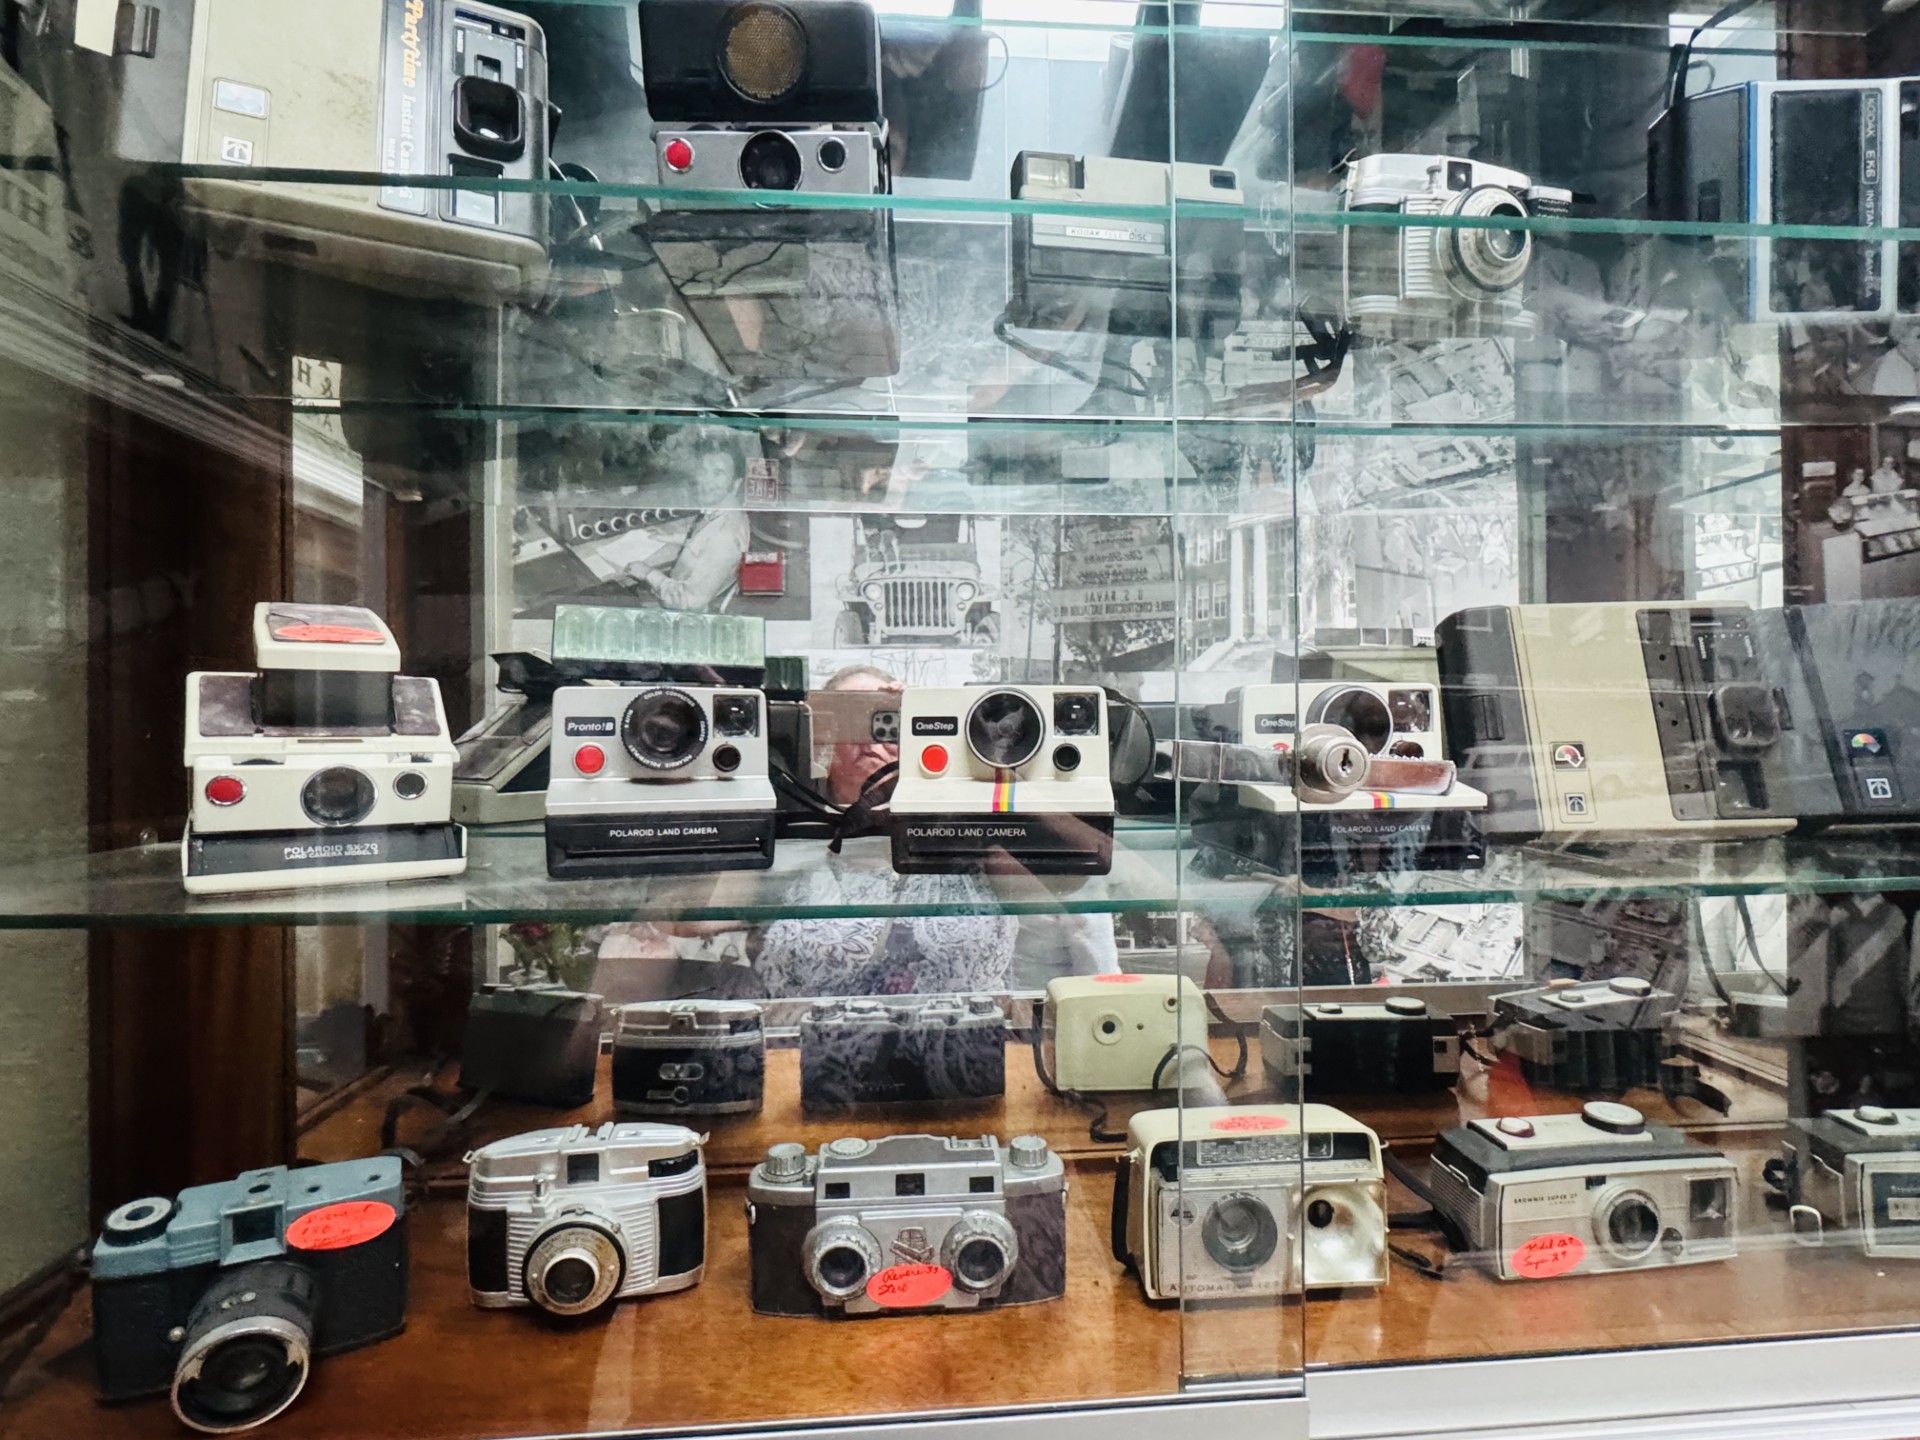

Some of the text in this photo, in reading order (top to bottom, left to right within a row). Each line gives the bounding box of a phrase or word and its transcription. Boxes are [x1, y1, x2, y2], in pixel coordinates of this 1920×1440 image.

[402, 94, 417, 140] Instant
[1071, 228, 1100, 237] KODAK
[915, 721, 954, 732] OneStep
[1260, 718, 1296, 728] OneStep
[609, 826, 718, 838] POLAROID LAND CAMERA
[906, 827, 1026, 837] POLAROID LAND CAMERA
[1331, 824, 1431, 834] POLAROID LAND CAMERA
[284, 842, 378, 855] POLAROID SX-70
